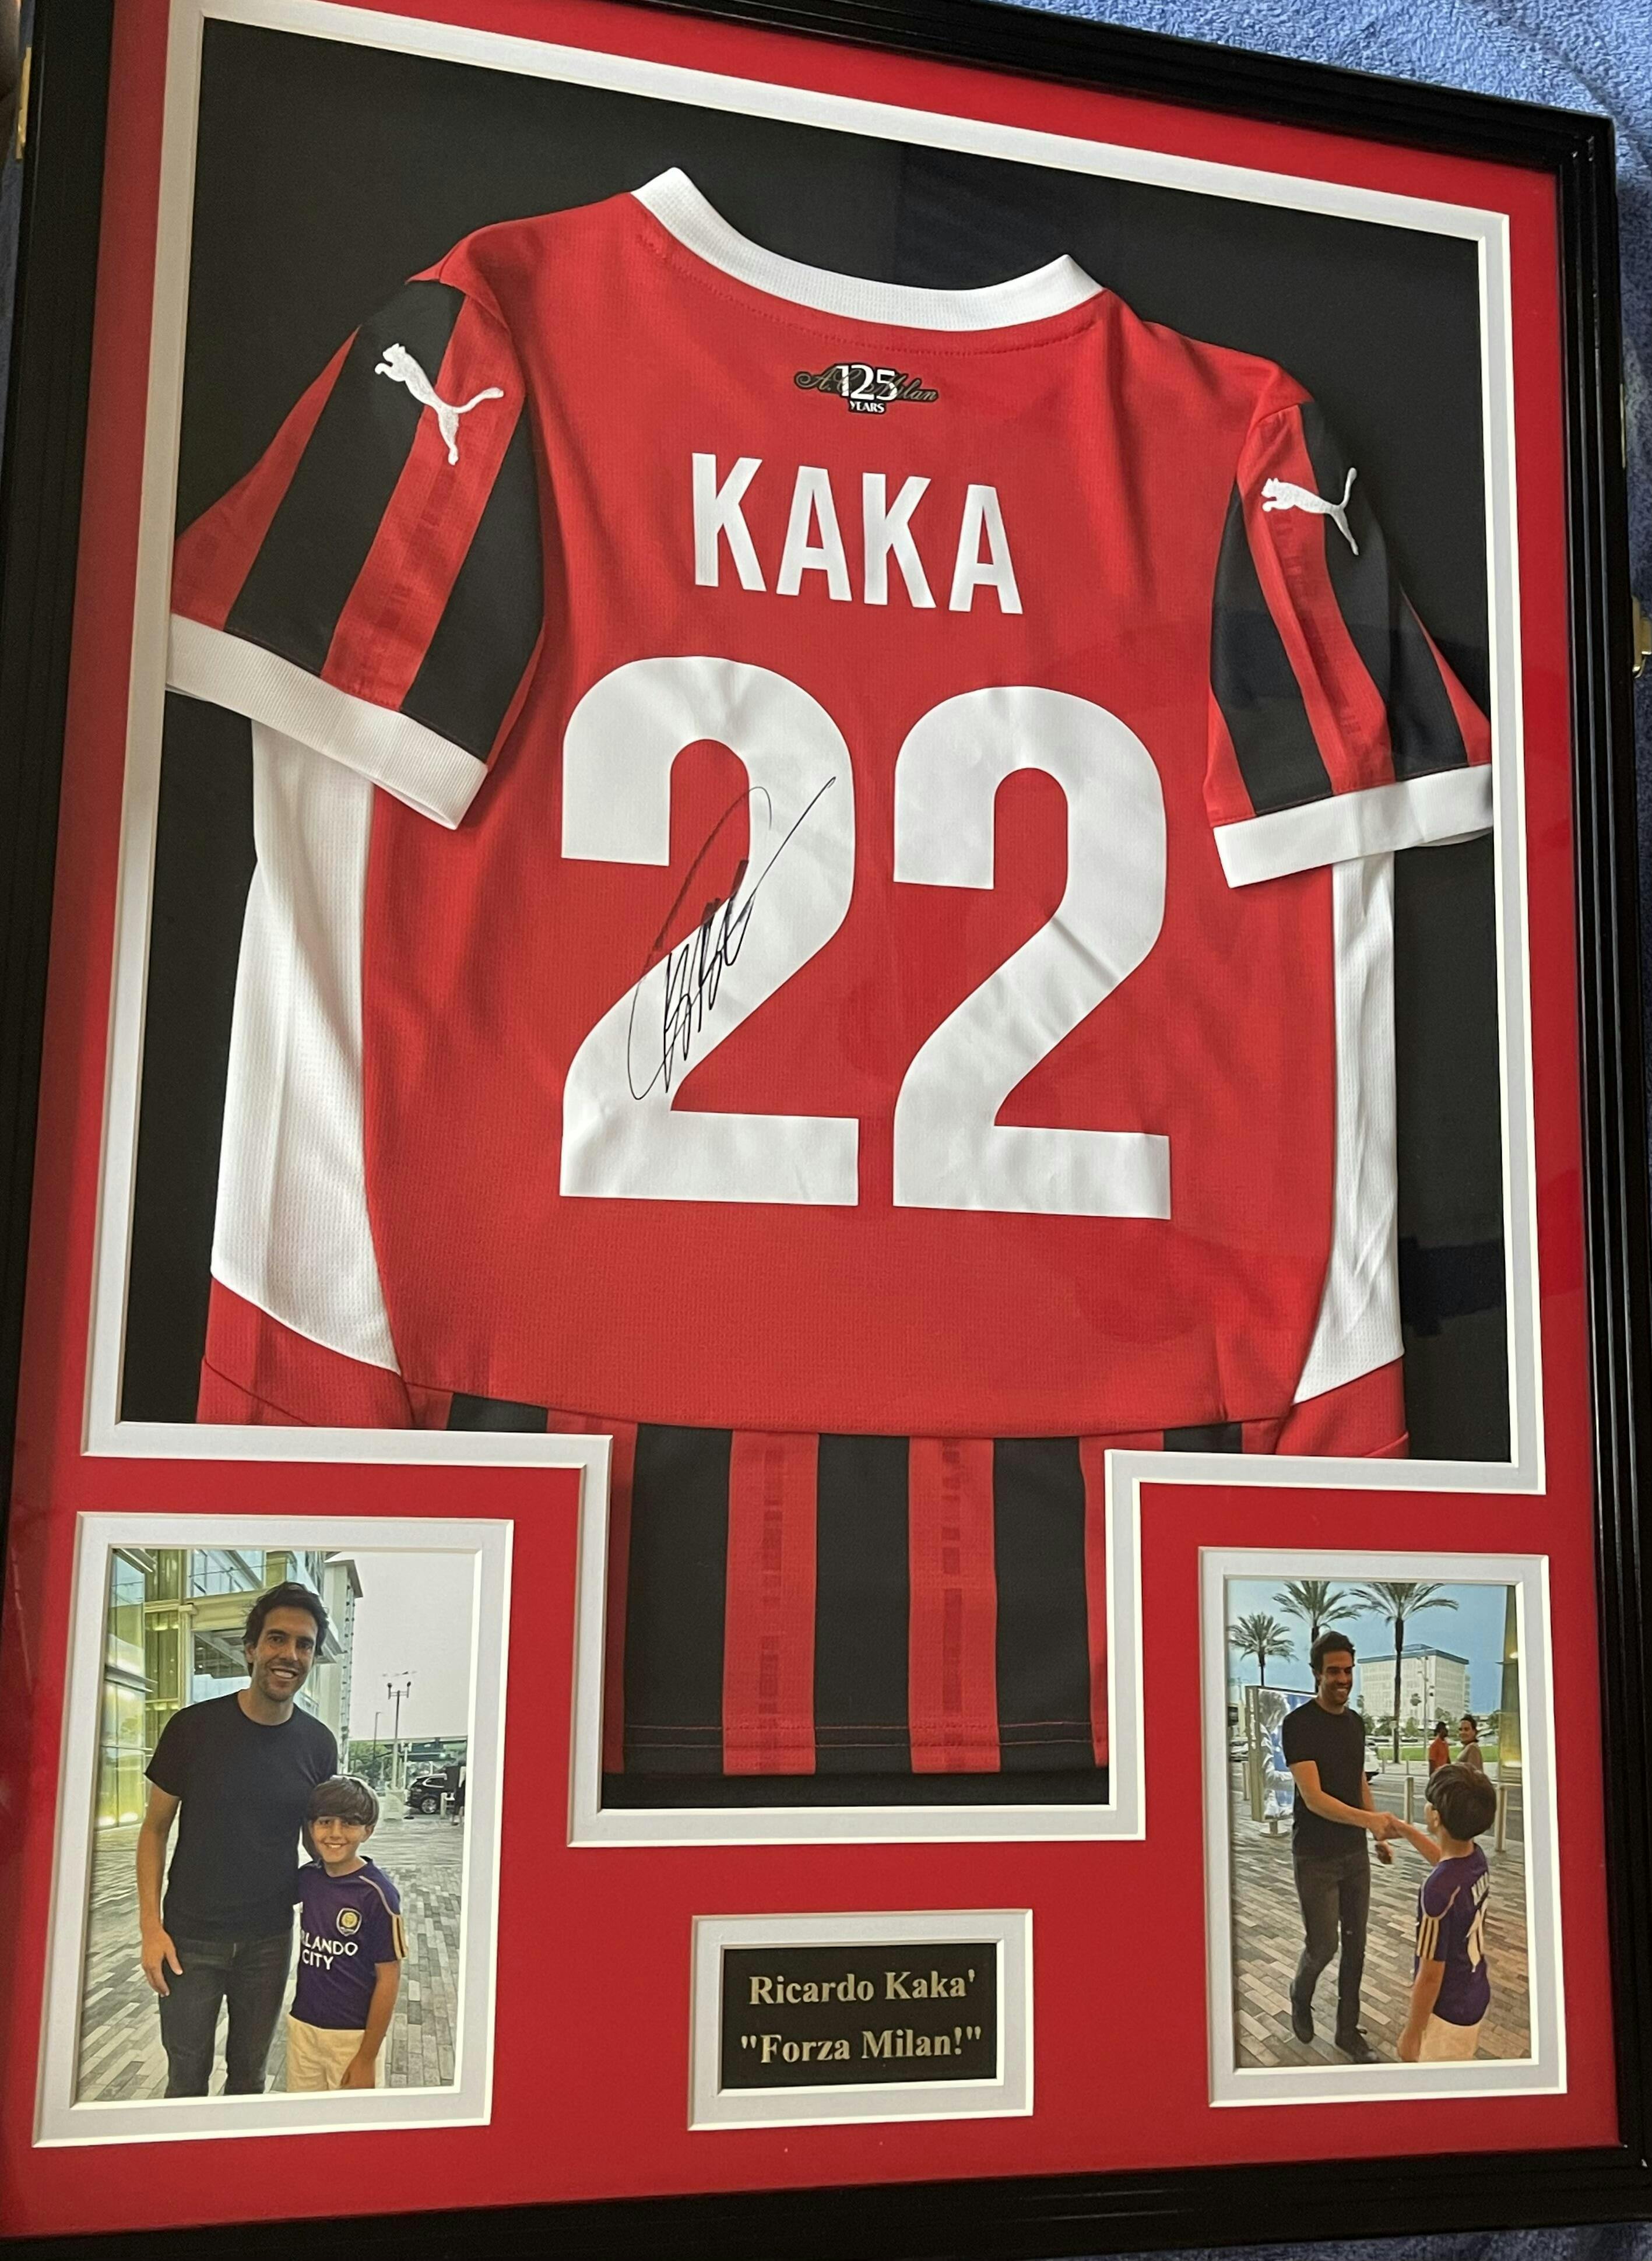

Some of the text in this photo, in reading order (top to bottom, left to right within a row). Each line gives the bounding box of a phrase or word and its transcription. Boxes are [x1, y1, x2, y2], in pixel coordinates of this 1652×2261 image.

[836, 364, 898, 400] 125
[849, 400, 885, 413] YEARS
[692, 452, 1023, 615] KAKA
[560, 656, 1171, 1219] 22
[302, 1949, 333, 1970] CITY
[749, 1968, 976, 2005] Ricardo Kaka'
[740, 2026, 982, 2063] "Forza Milan!"
